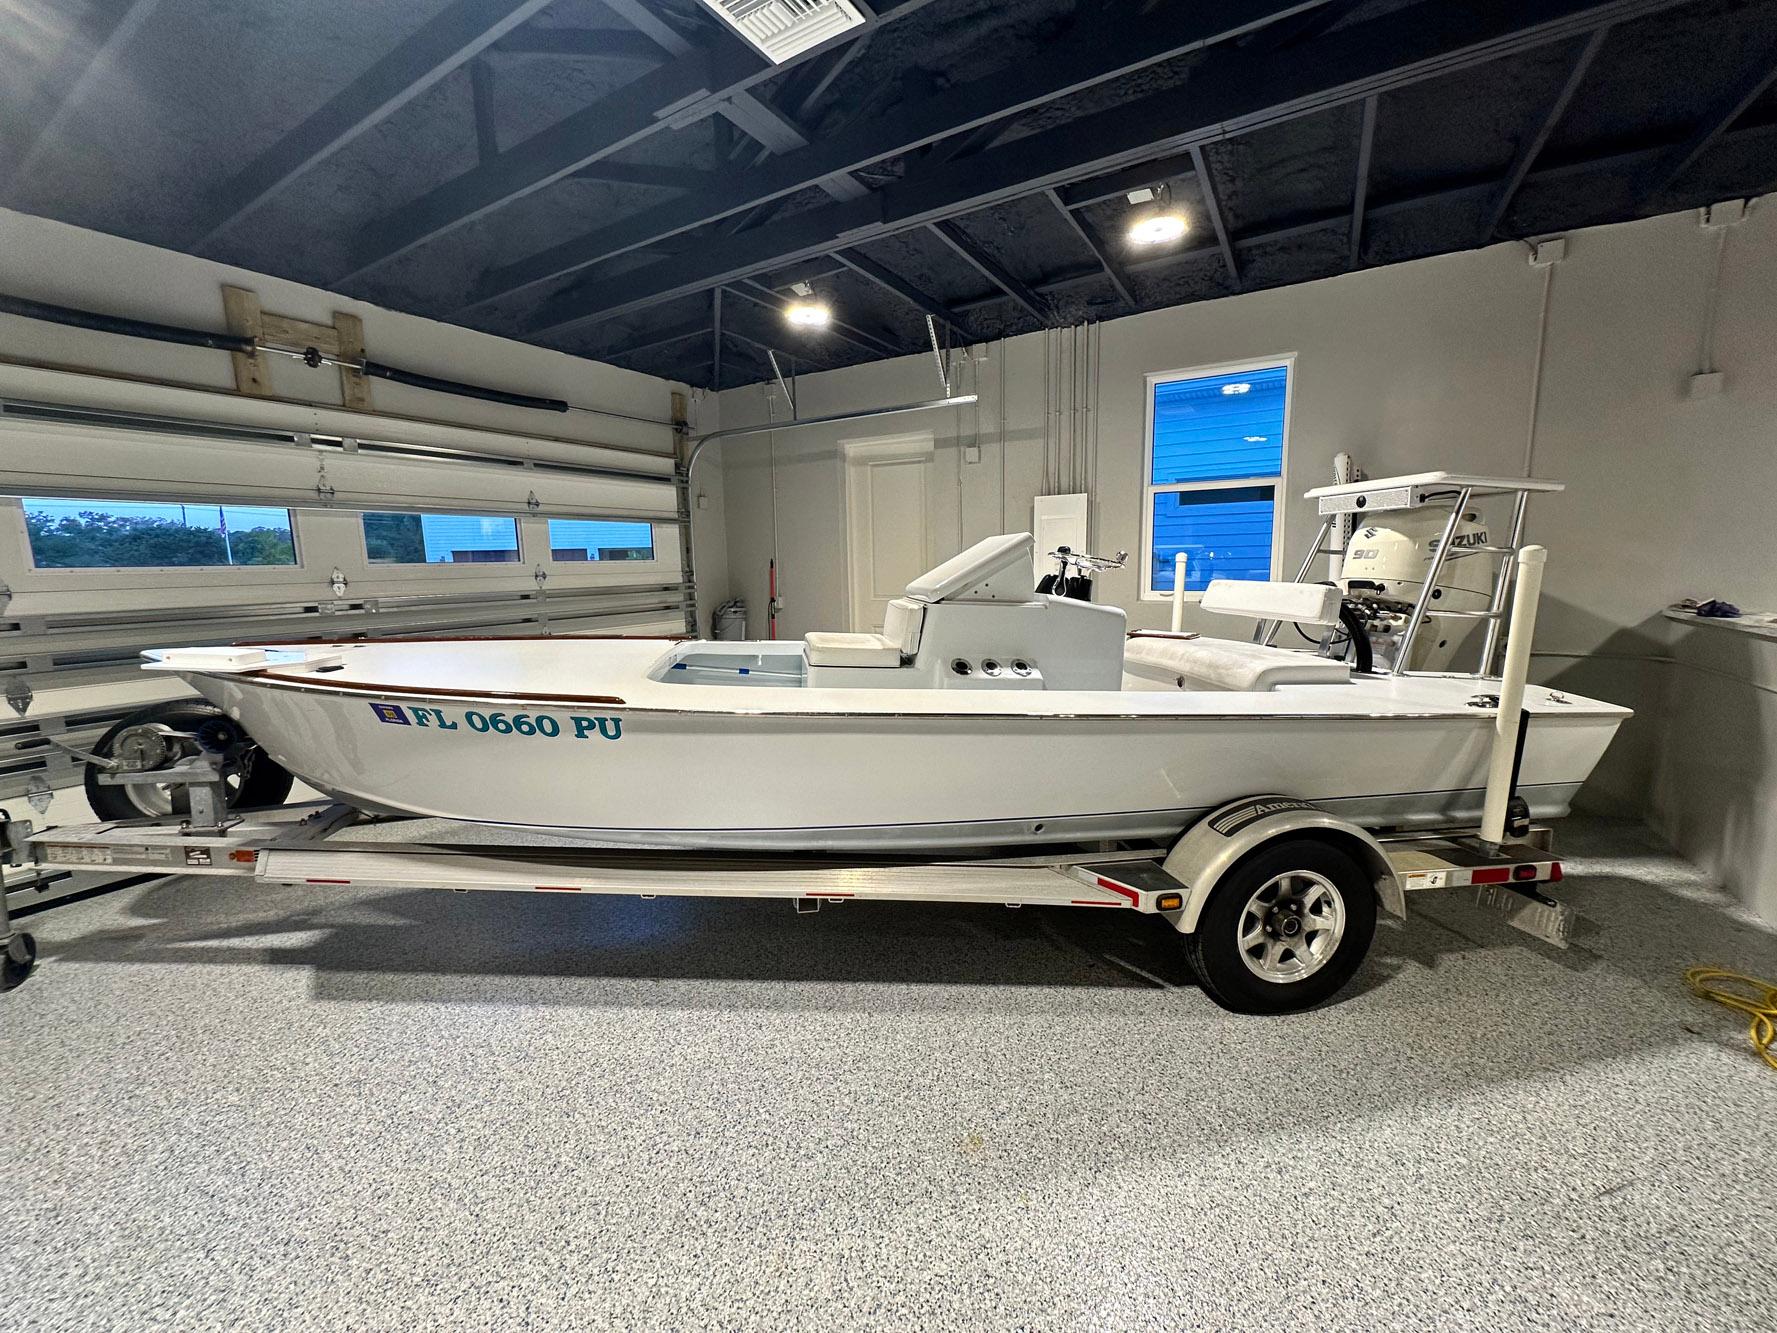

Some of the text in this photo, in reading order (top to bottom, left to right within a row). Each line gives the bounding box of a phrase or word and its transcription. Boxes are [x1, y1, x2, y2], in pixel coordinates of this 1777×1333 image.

[1352, 549, 1380, 560] 90
[407, 706, 622, 740] FL 0660 PU
